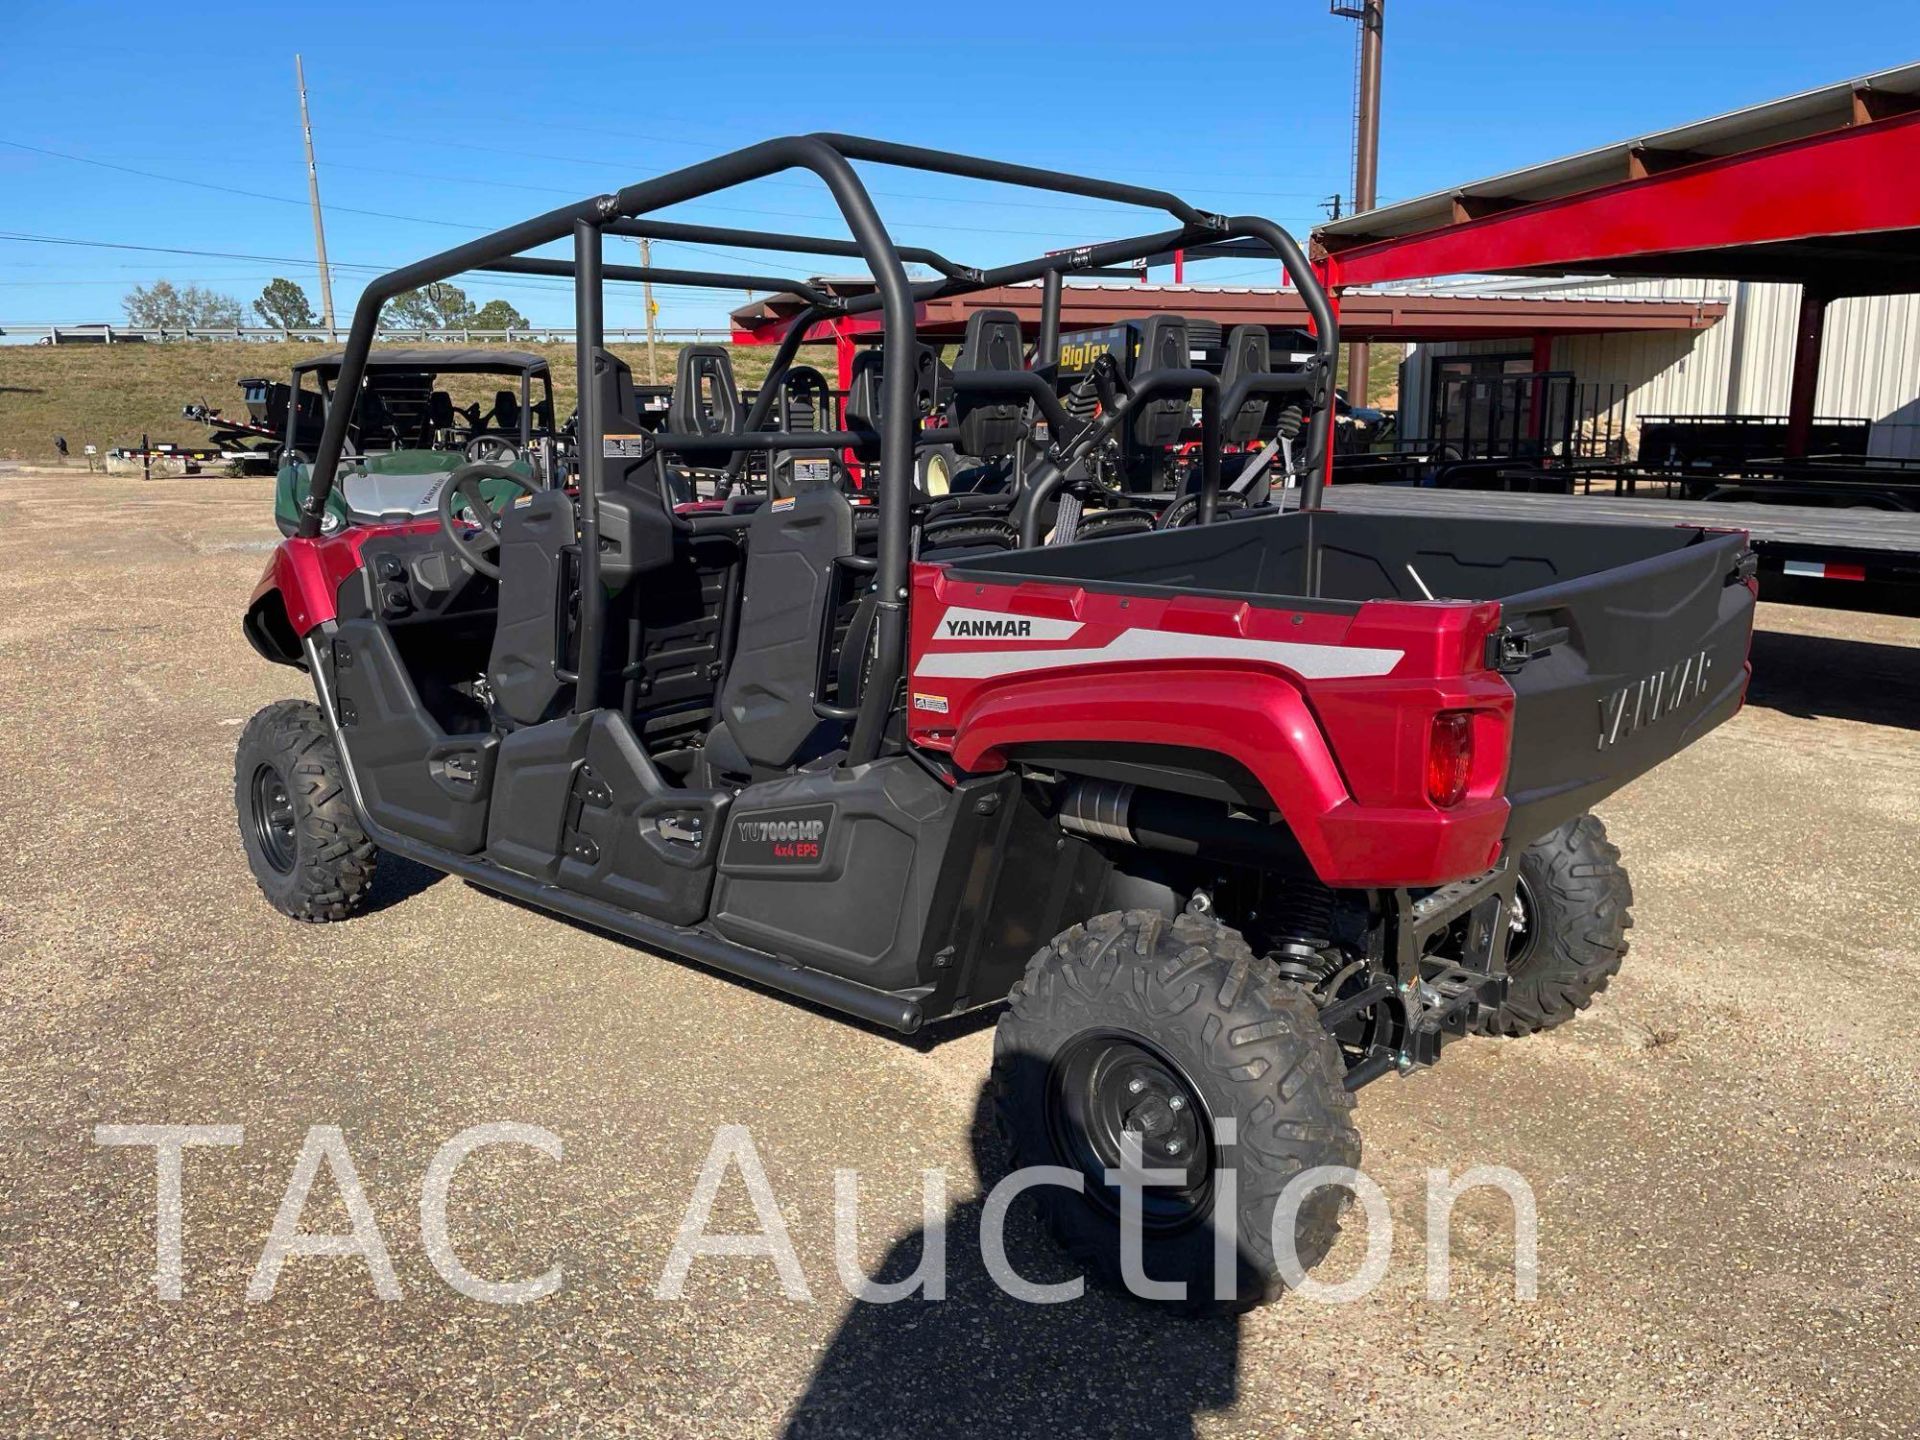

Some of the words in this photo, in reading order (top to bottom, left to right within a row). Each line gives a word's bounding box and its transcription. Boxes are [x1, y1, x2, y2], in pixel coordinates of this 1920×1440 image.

[946, 620, 1031, 636] YANMAR
[738, 820, 825, 842] YU700GMP
[774, 843, 794, 857] 4x4
[797, 843, 818, 857] EPS
